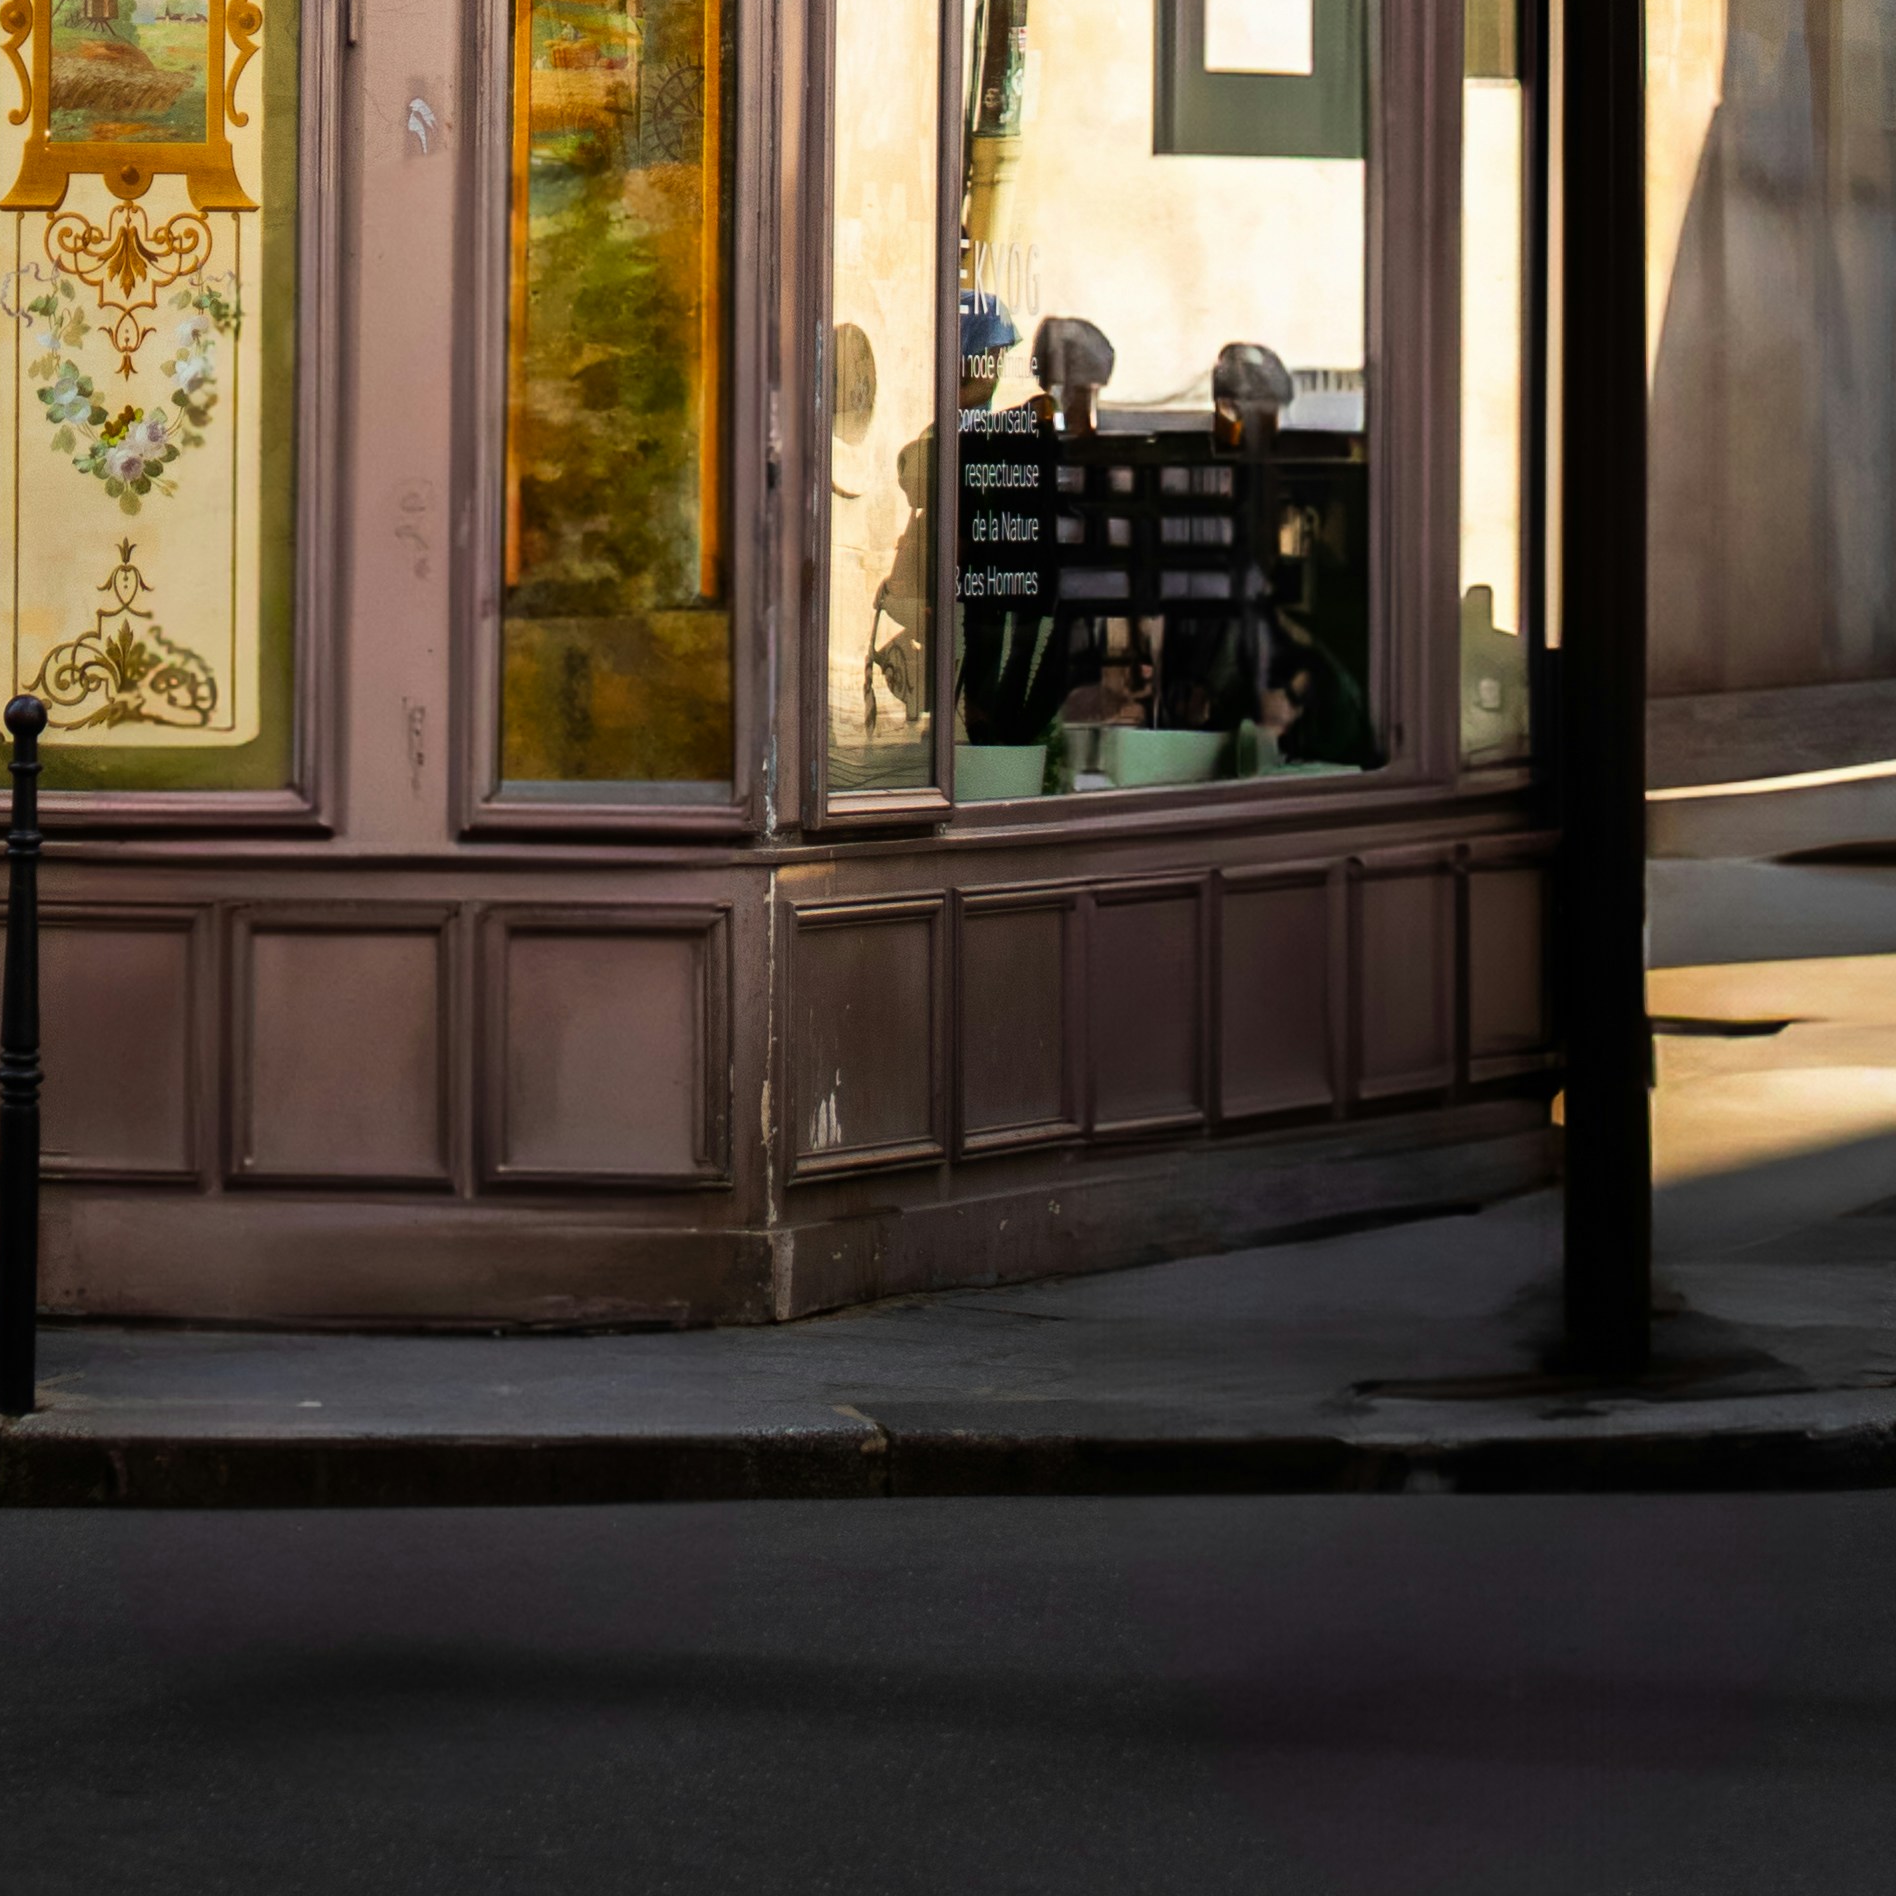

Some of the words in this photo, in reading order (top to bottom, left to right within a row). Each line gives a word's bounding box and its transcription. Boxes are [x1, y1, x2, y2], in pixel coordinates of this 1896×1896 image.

[959, 239, 1040, 315] EKYOG
[964, 459, 1040, 495] respectueuse
[971, 510, 986, 542] de
[989, 509, 999, 542] la
[1001, 511, 1039, 542] Nature
[964, 564, 985, 596] des
[986, 565, 1039, 596] Hommes
